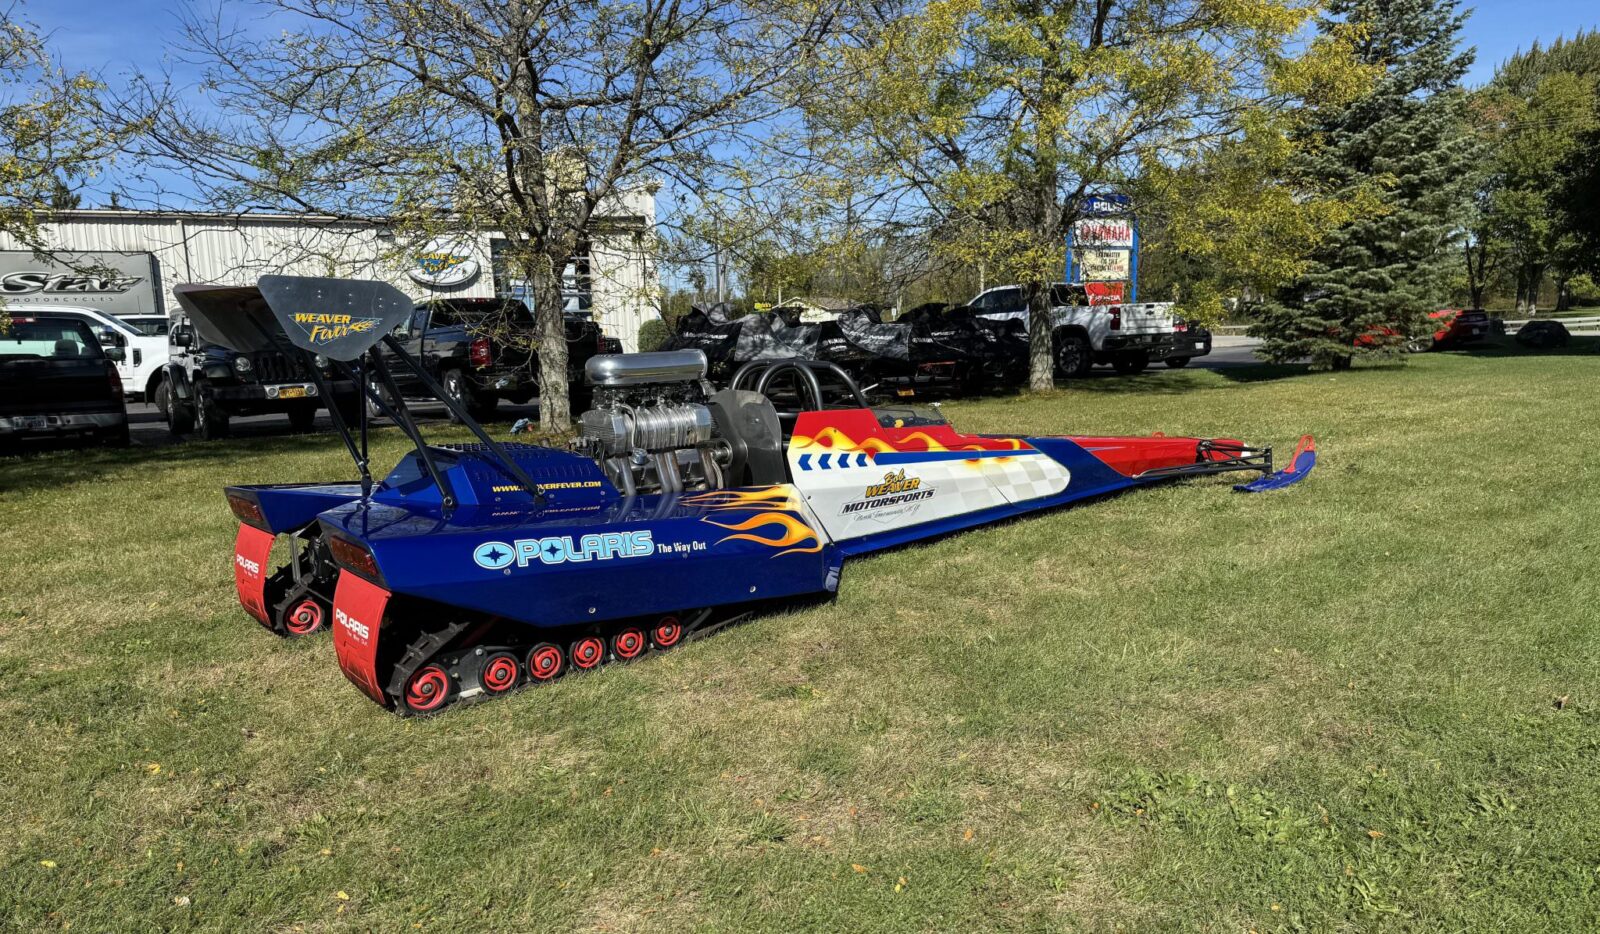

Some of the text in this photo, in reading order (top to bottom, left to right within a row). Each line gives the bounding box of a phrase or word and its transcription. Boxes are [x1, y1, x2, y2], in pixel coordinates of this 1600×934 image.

[0, 271, 144, 294] Star
[295, 312, 351, 324] WEAVER
[309, 324, 349, 342] Fever
[865, 477, 921, 498] WEAVER
[884, 468, 905, 485] Bob
[842, 489, 935, 514] MOTORSPORTS
[514, 530, 706, 567] POLARIS The Way Out
[336, 608, 369, 640] POLARIS
